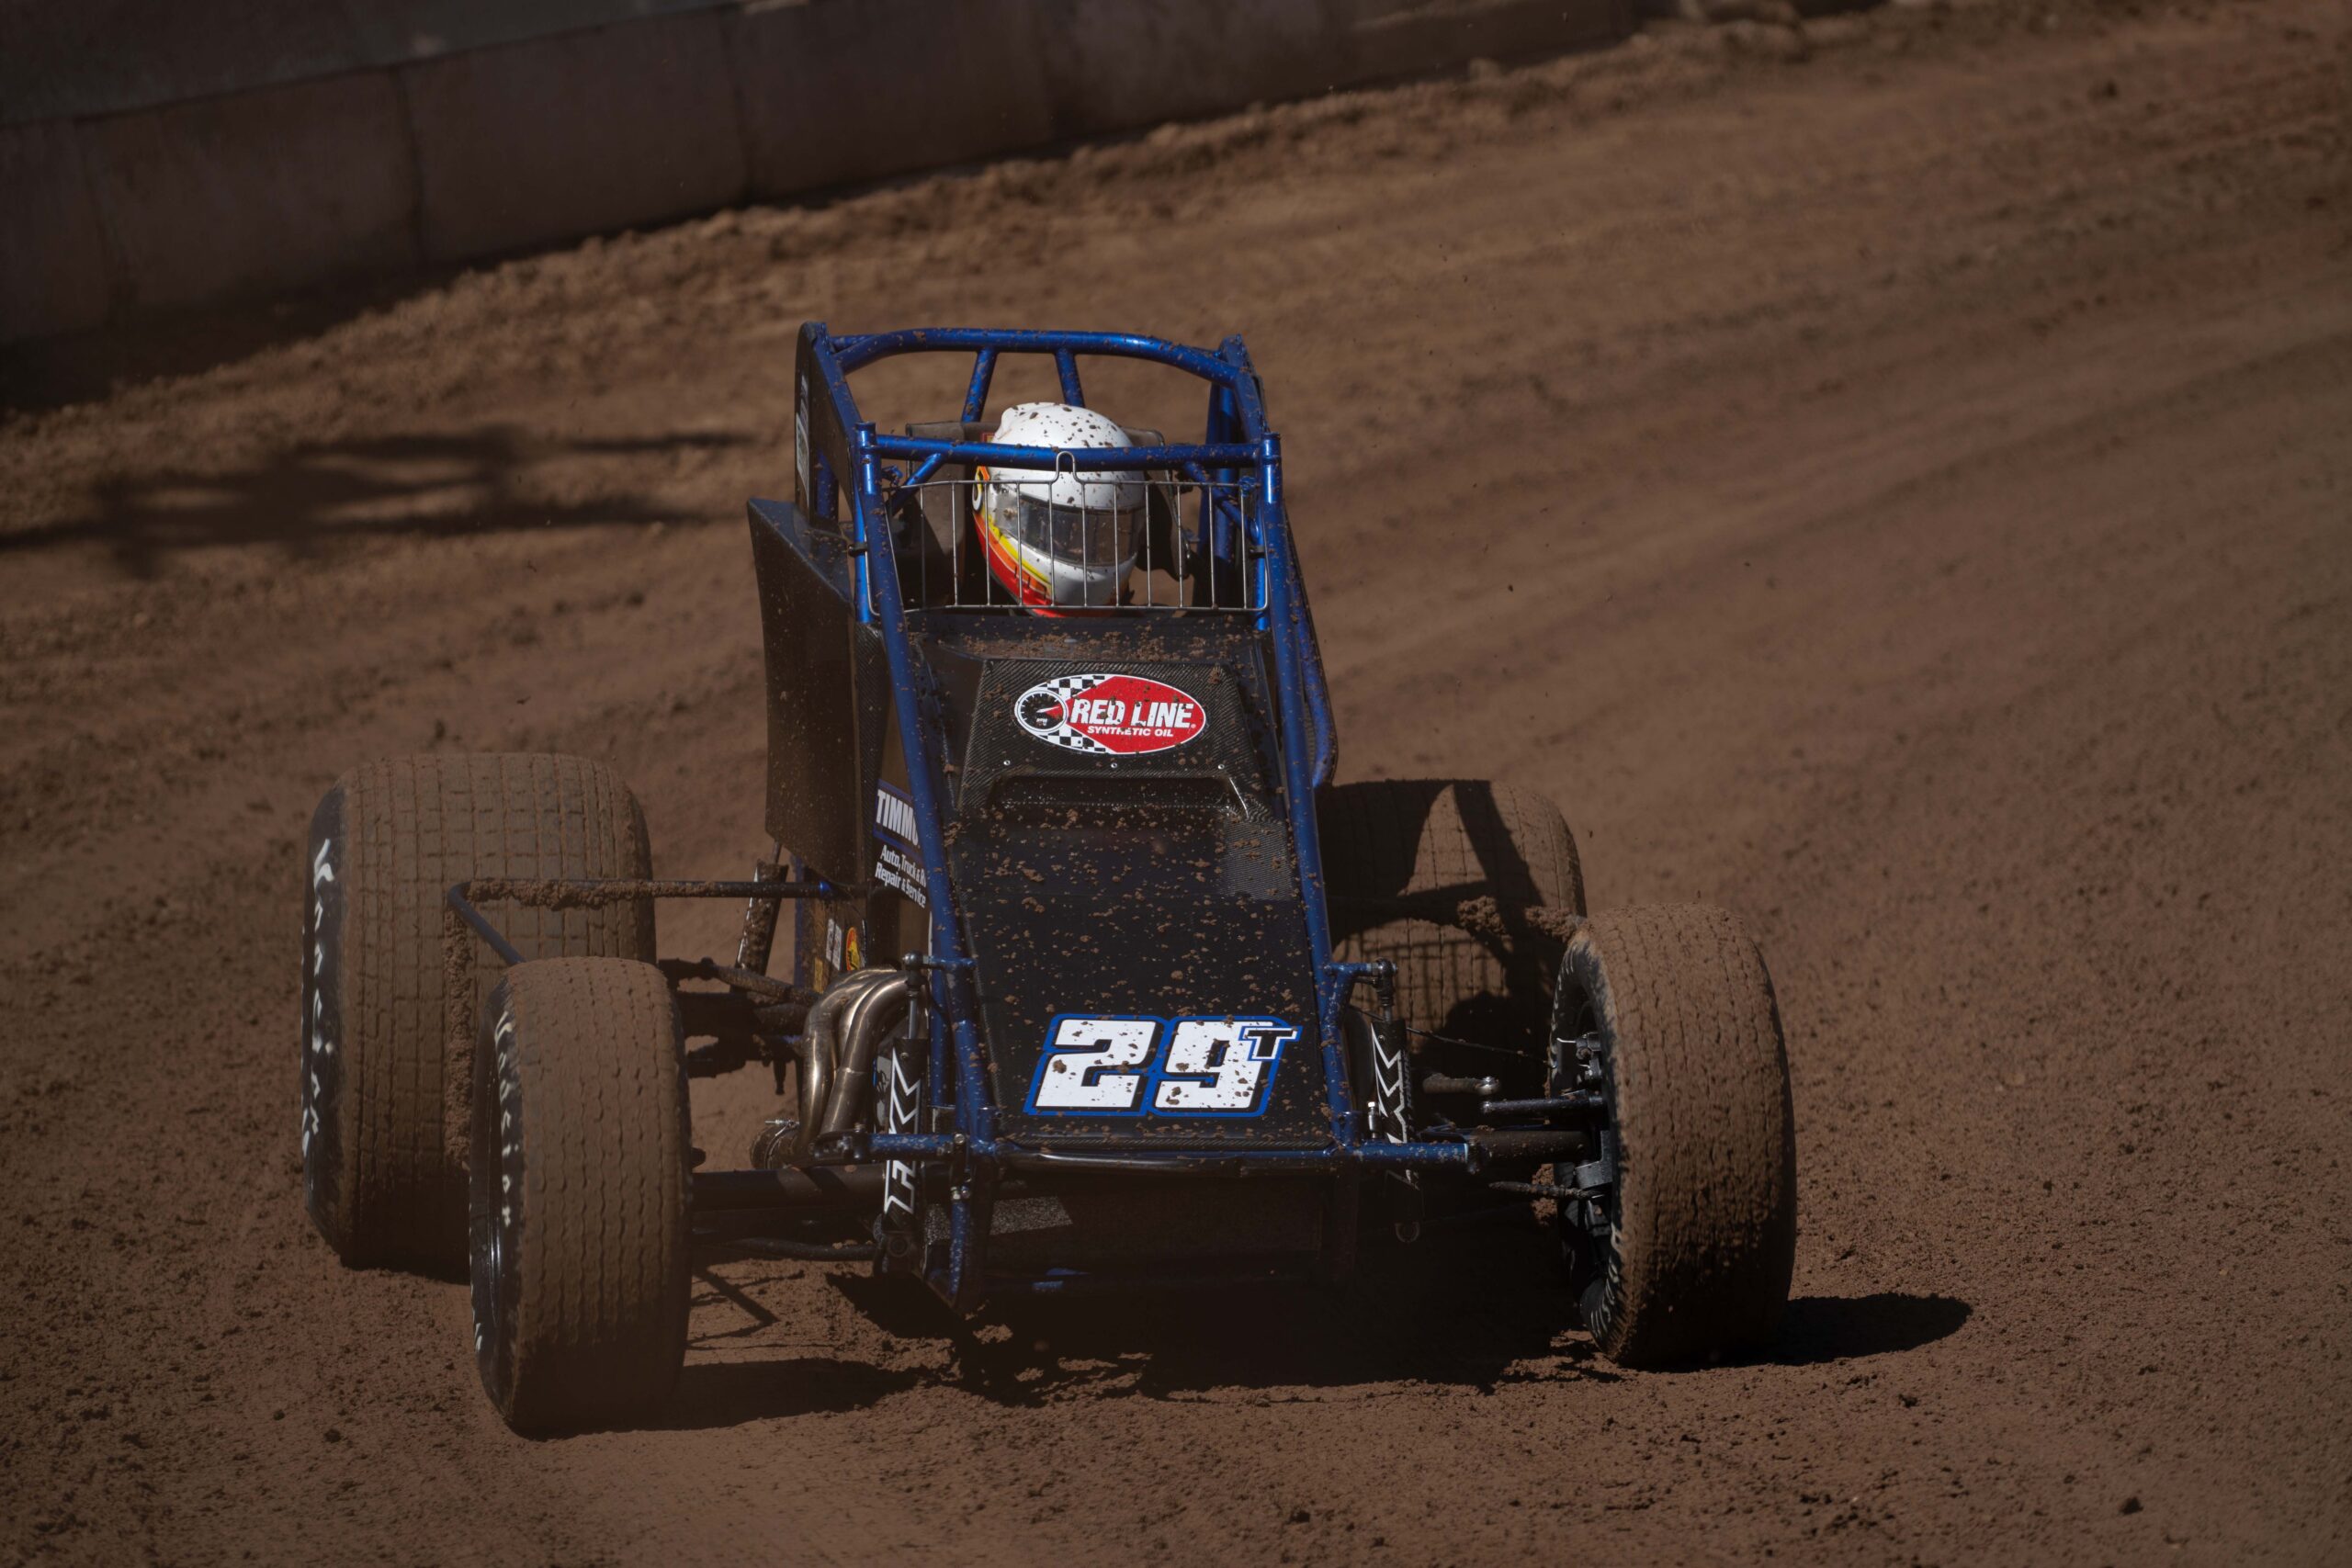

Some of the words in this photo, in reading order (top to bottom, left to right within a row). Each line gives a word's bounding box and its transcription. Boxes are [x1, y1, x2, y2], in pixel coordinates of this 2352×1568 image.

[1070, 698, 1126, 725] RED
[1130, 701, 1194, 728] LINE
[1087, 725, 1151, 737] SYNTHETIC
[1154, 727, 1174, 738] OIL
[880, 844, 900, 872] Auto,
[901, 853, 917, 880] Truck
[875, 861, 901, 888] Repair
[905, 878, 926, 909] Service
